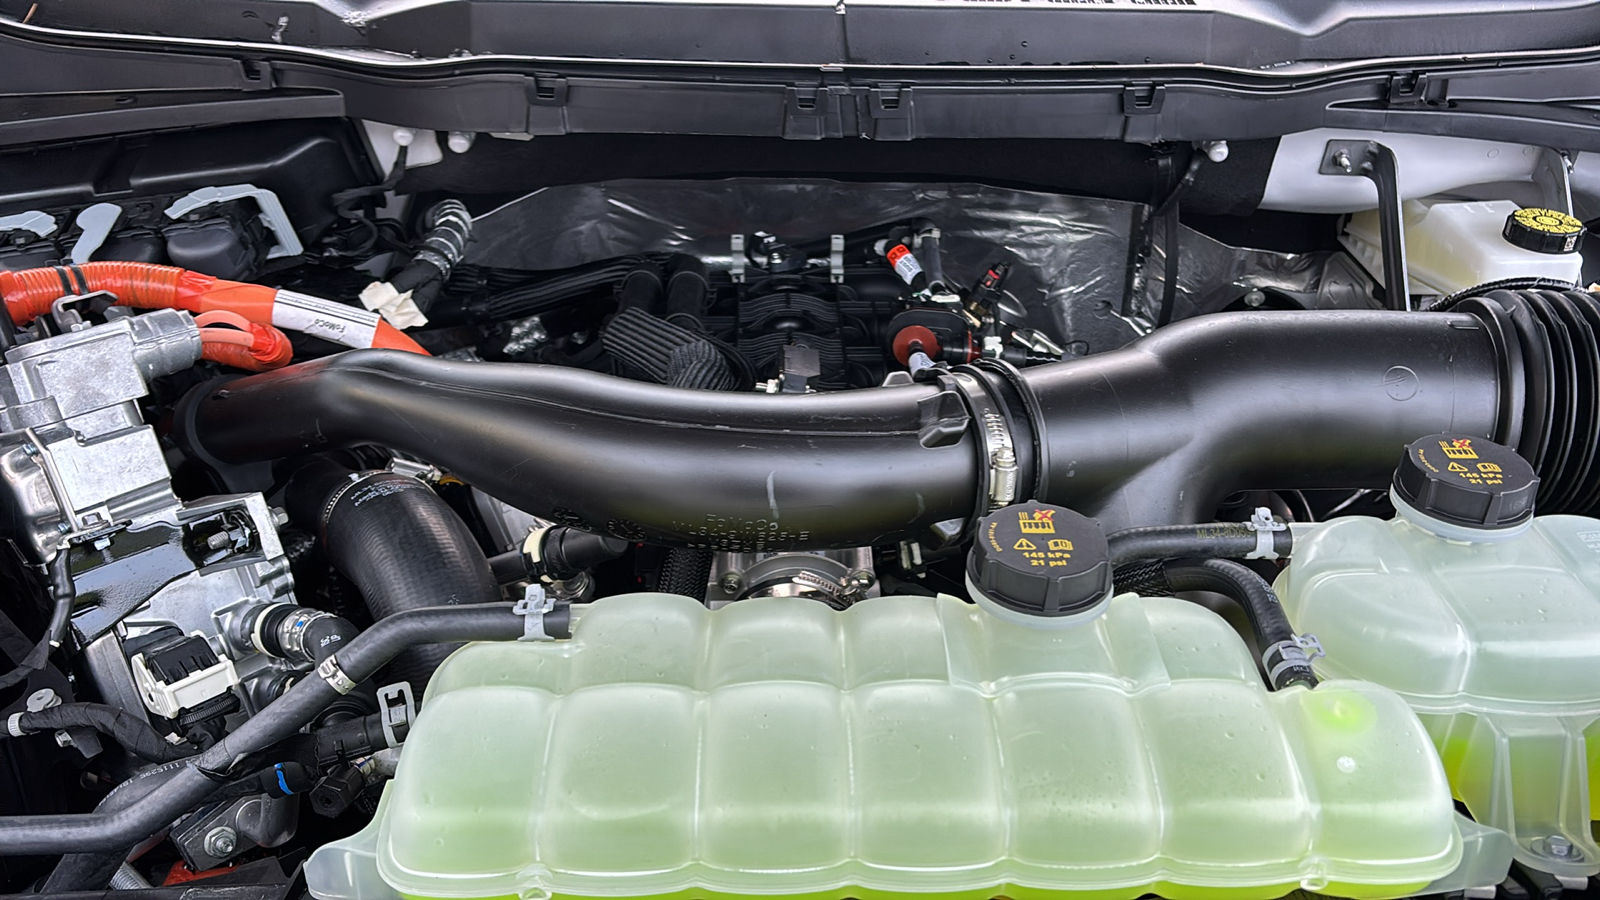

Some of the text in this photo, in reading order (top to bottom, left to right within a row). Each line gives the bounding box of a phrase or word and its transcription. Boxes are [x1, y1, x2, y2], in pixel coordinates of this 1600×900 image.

[314, 318, 346, 333] FoMoCo
[1022, 551, 1071, 559] 145 kPa
[1048, 559, 1067, 567] psi
